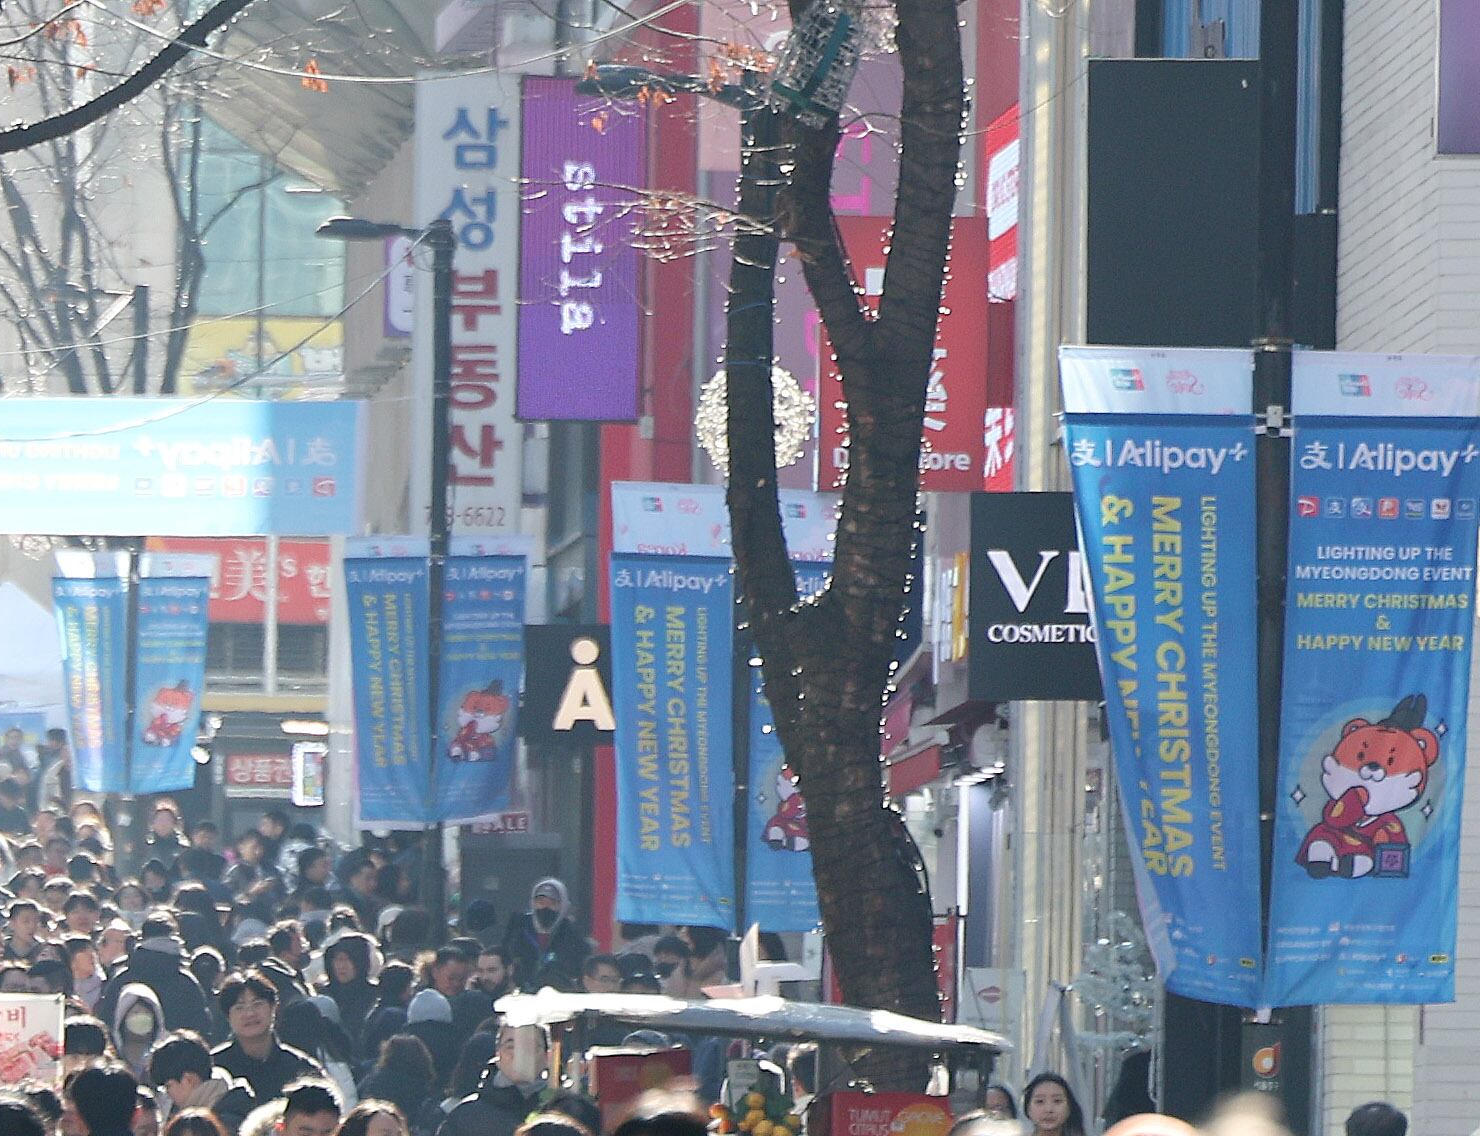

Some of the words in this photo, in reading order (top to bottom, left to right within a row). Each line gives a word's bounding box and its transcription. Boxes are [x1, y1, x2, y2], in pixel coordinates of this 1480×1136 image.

[1100, 494, 1134, 527] &
[1151, 496, 1184, 634] MERRY
[1199, 496, 1218, 588] LIGHTING
[1317, 546, 1395, 561] LIGHTING
[1399, 547, 1421, 561] UP
[1425, 547, 1454, 561] THE
[1102, 535, 1138, 672] HAPPY
[1294, 565, 1419, 581] MYEONGDONG
[1423, 567, 1473, 582] EVENT
[1296, 593, 1361, 609] MERRY
[1364, 594, 1469, 609] CHRISTMAS
[383, 593, 401, 654] MERRY
[634, 604, 656, 624] &
[1201, 591, 1218, 618] UP
[1376, 615, 1392, 630] &
[365, 612, 383, 673] HAPPY
[666, 605, 686, 693] MERRY
[1200, 623, 1218, 660] THE
[1297, 635, 1364, 650] HAPPY
[1368, 637, 1414, 651] NEW
[1416, 635, 1464, 651] YEAR
[635, 629, 657, 716] HAPPY
[638, 719, 660, 782] NEW
[667, 697, 693, 849] CHRISTMAS
[1156, 640, 1194, 877] CHRISTMAS
[639, 786, 661, 852] YEAR
